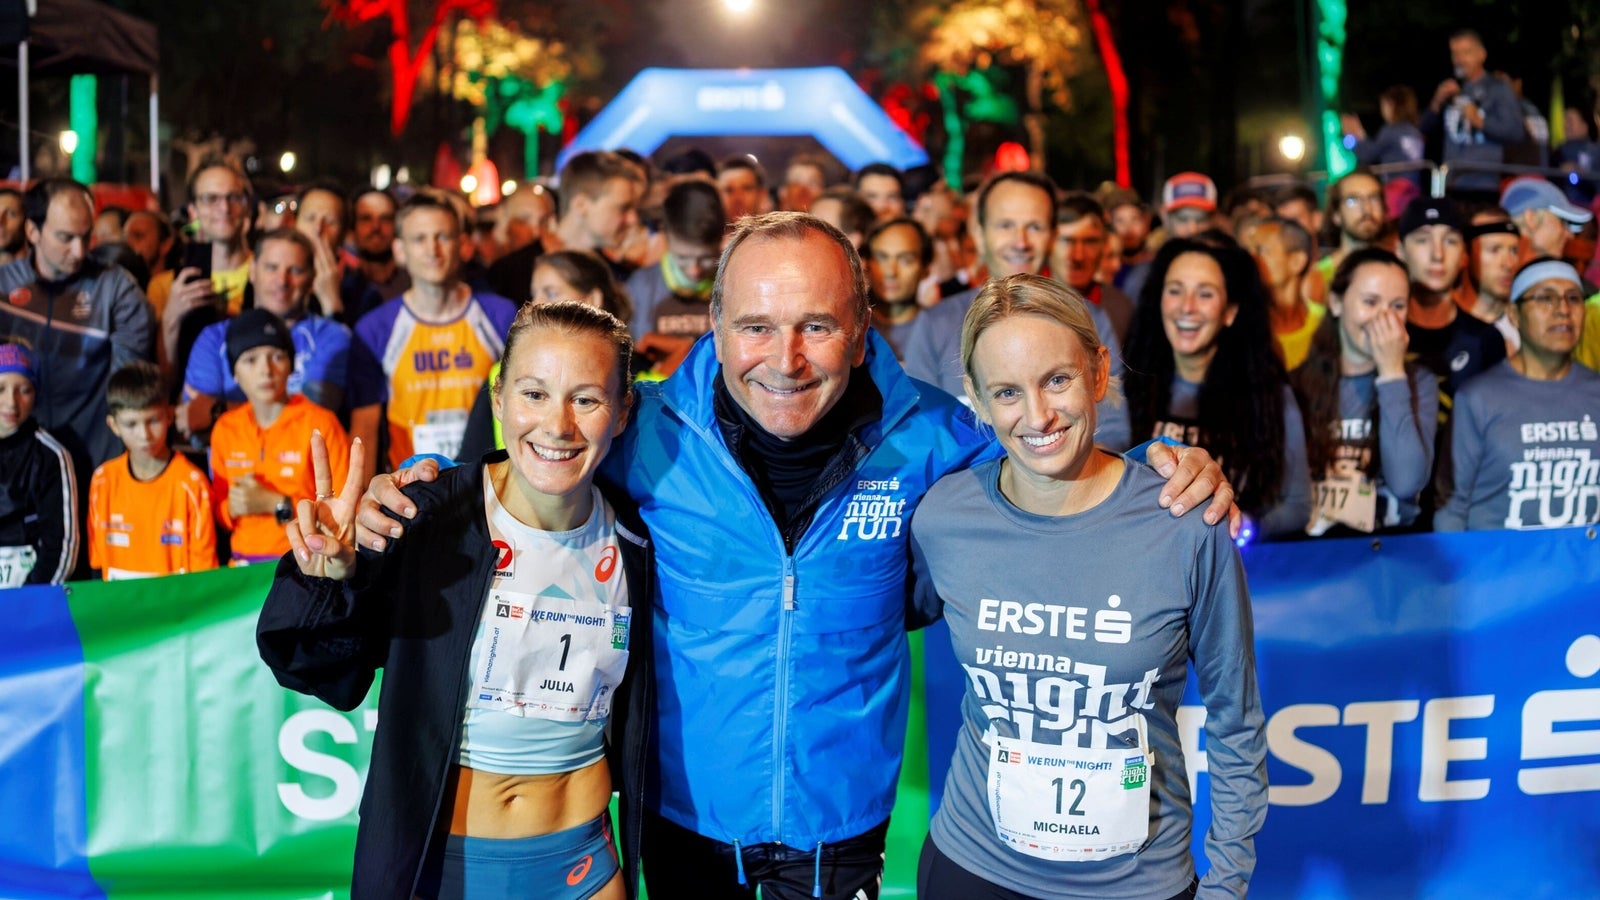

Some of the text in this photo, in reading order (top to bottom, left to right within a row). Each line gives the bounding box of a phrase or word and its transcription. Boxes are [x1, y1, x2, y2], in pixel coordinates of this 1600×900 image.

[414, 350, 450, 373] ULC
[1521, 422, 1579, 443] ERSTE
[1523, 446, 1574, 461] vienna
[1508, 448, 1600, 497] nigh
[852, 492, 881, 501] vienna
[857, 480, 888, 490] ERSTE
[844, 495, 906, 522] night
[836, 516, 902, 540] run
[531, 609, 546, 620] WE
[546, 611, 567, 622] RUN
[575, 615, 606, 627] NIGHT!
[977, 599, 1088, 640] ERSTE
[558, 633, 572, 671] 1
[976, 645, 1071, 674] vienna
[539, 680, 575, 693] JULIA
[961, 662, 1161, 731] night
[277, 708, 379, 822] S
[1027, 756, 1043, 766] WE
[1043, 757, 1066, 768] RUN
[1075, 760, 1112, 771] NIGHT!
[1051, 777, 1087, 816] 12
[1033, 820, 1100, 836] MICHAELA
